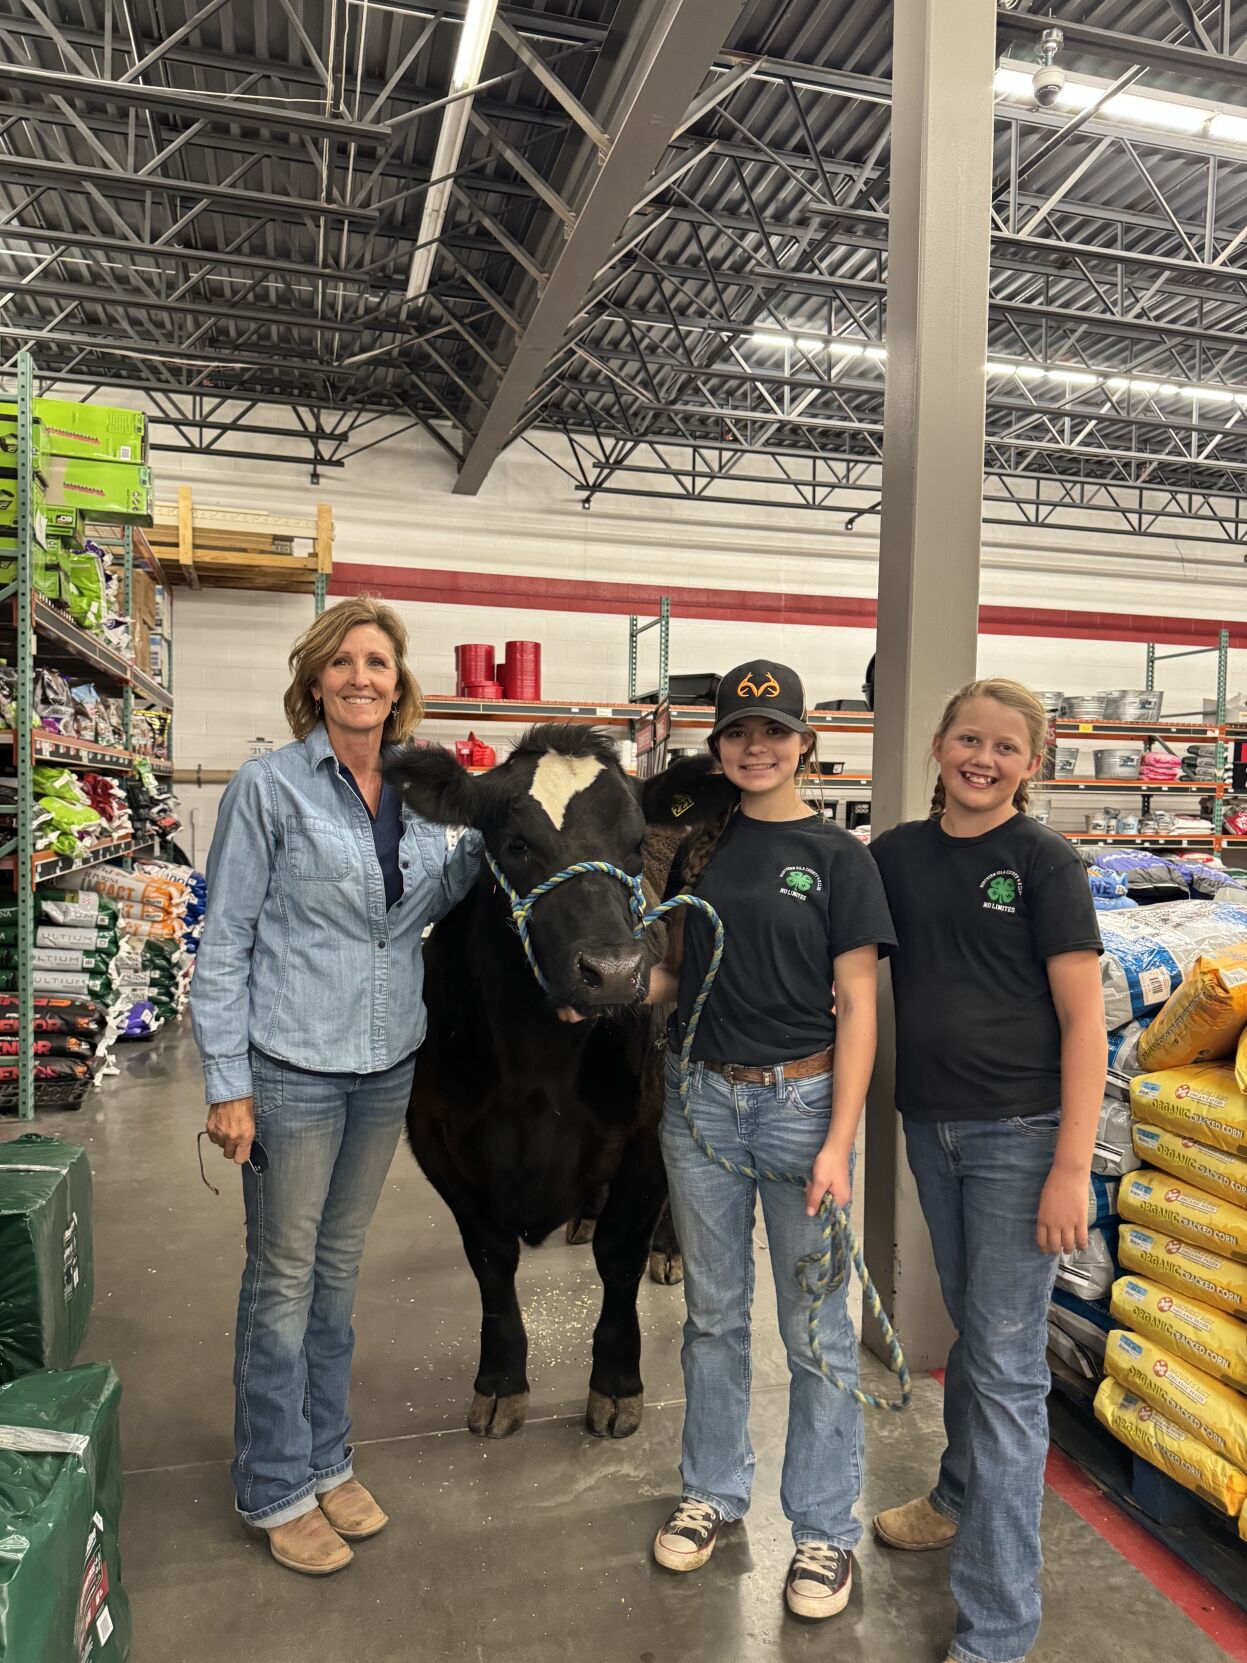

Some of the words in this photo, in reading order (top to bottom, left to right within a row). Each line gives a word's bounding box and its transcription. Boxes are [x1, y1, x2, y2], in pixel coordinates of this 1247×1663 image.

[41, 932, 93, 941] ULTIUM
[1151, 1099, 1191, 1119] ORGANIC
[1190, 1113, 1221, 1130] CRACKED
[1222, 1124, 1244, 1138] CORN
[1157, 1144, 1197, 1168] ORGANIC
[1195, 1163, 1229, 1185] CRACKED
[1231, 1181, 1247, 1196] COR
[1140, 1201, 1180, 1223] ORGANIC
[1180, 1216, 1213, 1236] CRACKED
[1213, 1230, 1238, 1245] CORN
[1140, 1251, 1181, 1275] ORGANIC
[1181, 1269, 1216, 1292] CRACKED
[1216, 1286, 1242, 1304] CORN
[1133, 1306, 1173, 1336] ORGANIC
[1172, 1330, 1205, 1355] CRACKED
[1206, 1351, 1230, 1369] CORN
[1129, 1365, 1168, 1402] ORGANIC
[1167, 1397, 1201, 1429] CRACKED
[1201, 1423, 1226, 1447] CORN
[1114, 1415, 1154, 1446] ORGANIC
[1181, 1460, 1202, 1479] CORN
